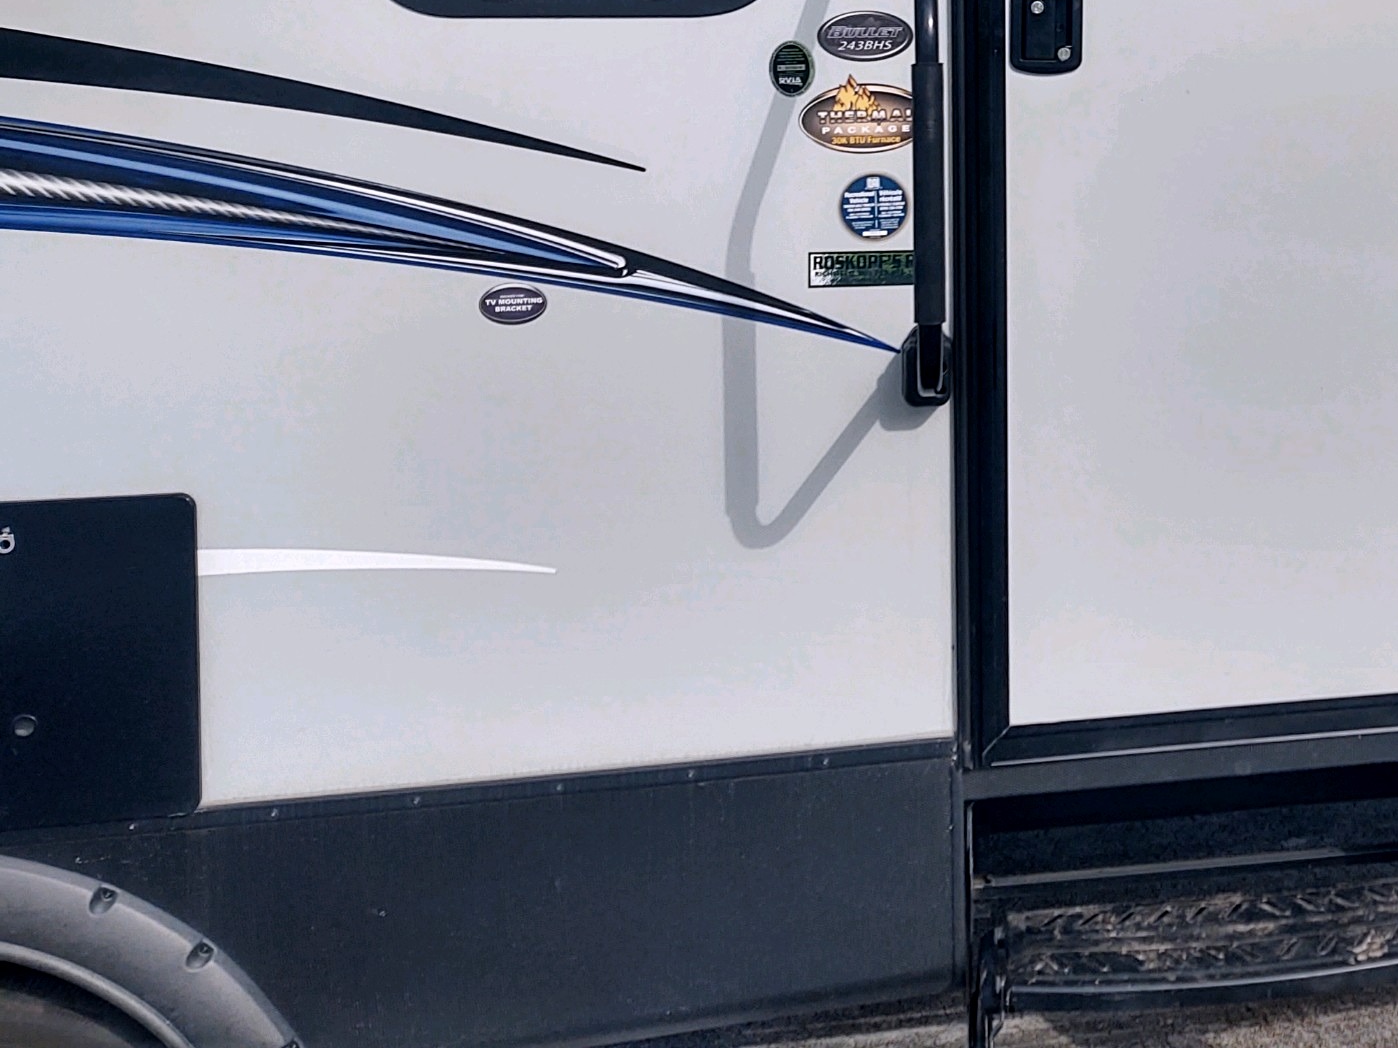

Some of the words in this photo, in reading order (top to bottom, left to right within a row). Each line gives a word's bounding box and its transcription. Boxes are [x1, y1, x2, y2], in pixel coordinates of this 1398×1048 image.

[827, 25, 902, 39] BULLET
[838, 40, 893, 51] 243BHS
[821, 124, 911, 134] PACKAGE
[849, 136, 866, 144] BTU
[867, 135, 901, 144] Furnace
